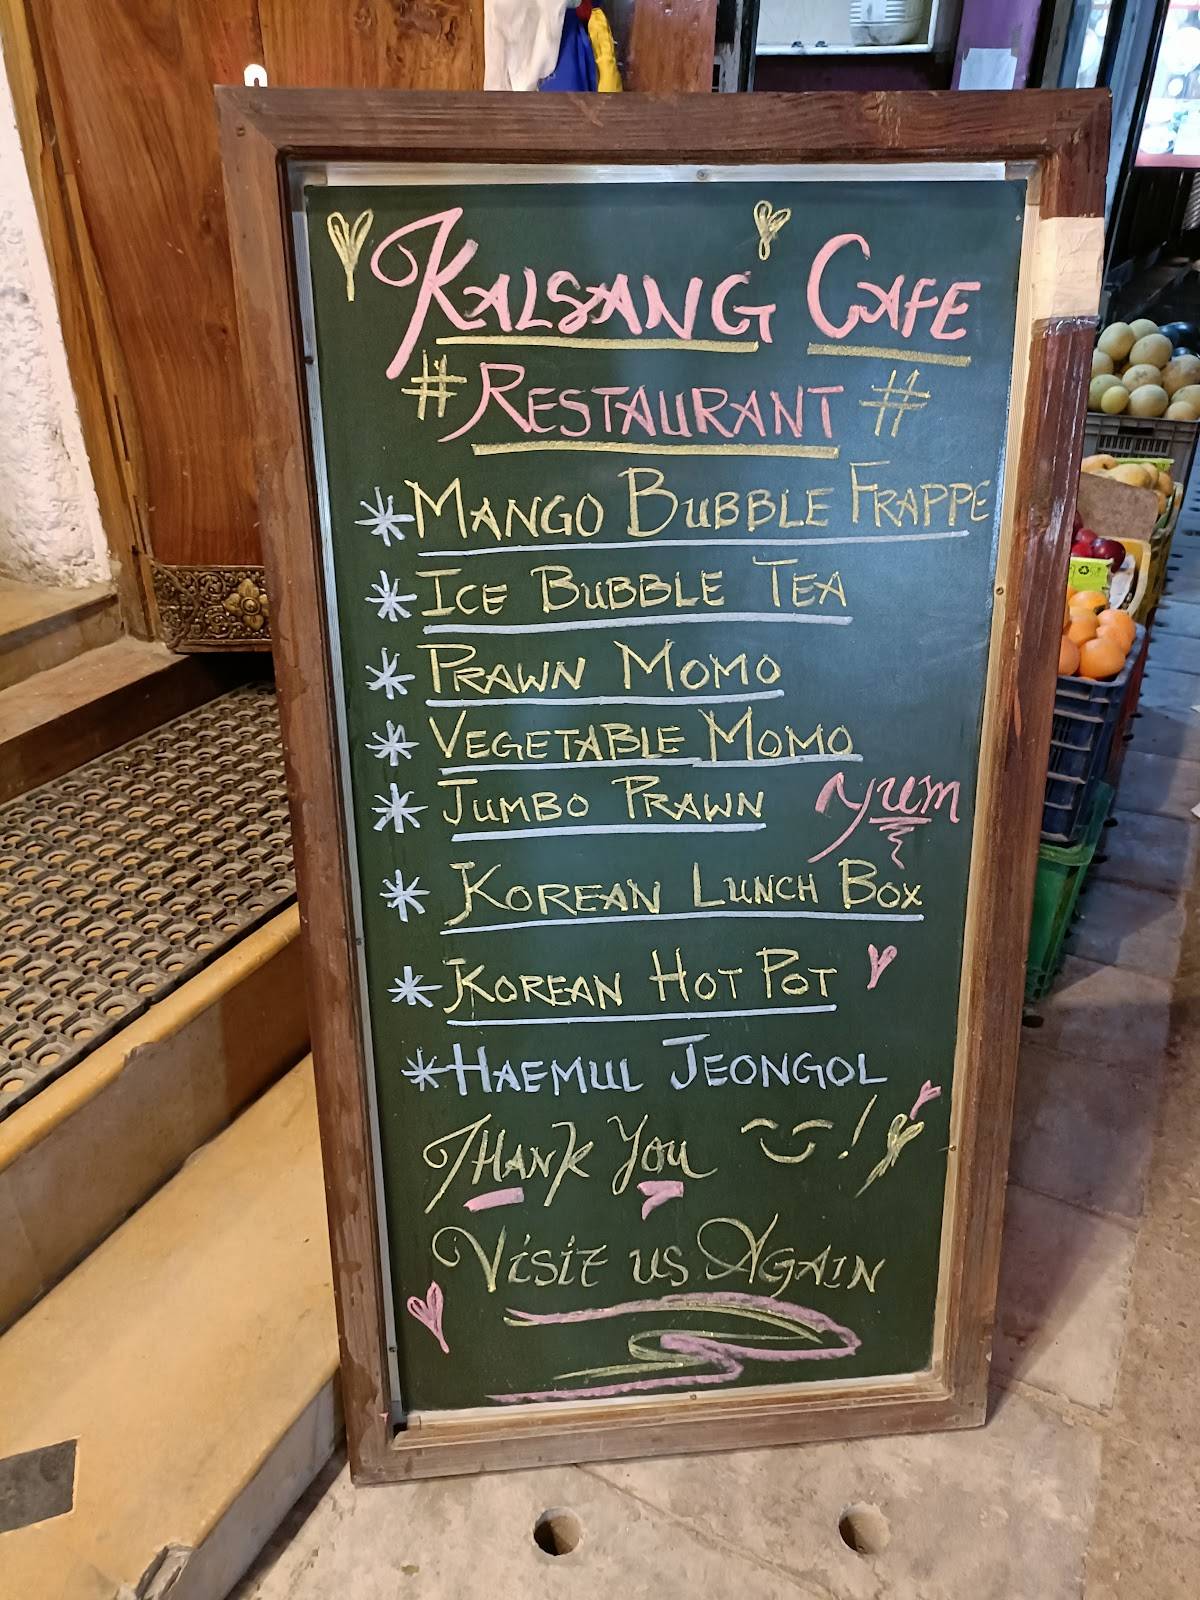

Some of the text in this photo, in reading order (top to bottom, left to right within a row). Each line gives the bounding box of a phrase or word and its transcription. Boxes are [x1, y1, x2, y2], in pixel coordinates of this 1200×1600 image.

[371, 207, 981, 378] KALSANG CAFE
[437, 362, 846, 443] RESTAURANT
[404, 478, 604, 540] MANGO
[849, 460, 993, 528] FRAPPE
[416, 568, 508, 617] ICE
[752, 555, 848, 607] TEA
[417, 638, 782, 695] PRAWN MOMO
[428, 705, 855, 762] VEGETABLE MOMO
[610, 775, 765, 822] PRAWN
[444, 861, 662, 927] KOREAN
[837, 857, 924, 910] BOX
[443, 946, 838, 1014] KOREAN HOT POT
[445, 1033, 888, 1096] HAEMUL JEONGOL
[696, 1212, 887, 1298] AGAIN
